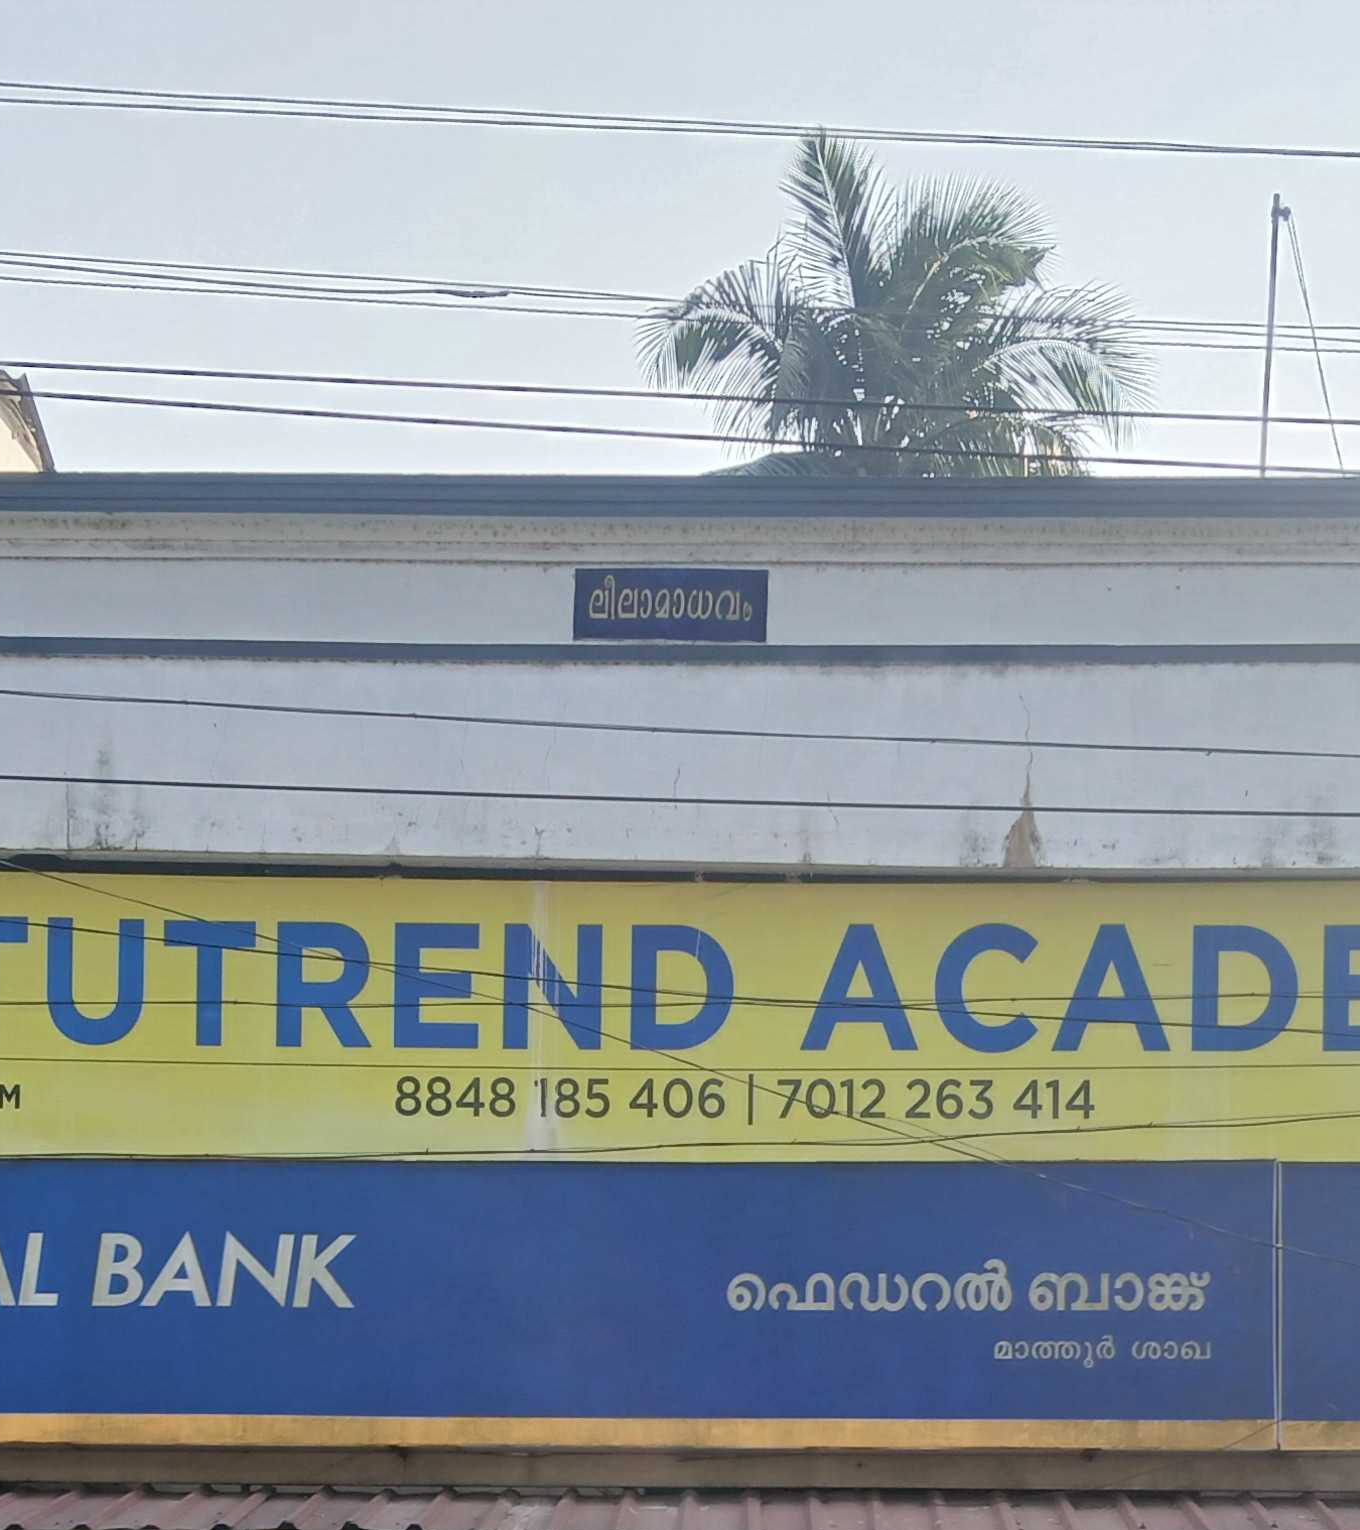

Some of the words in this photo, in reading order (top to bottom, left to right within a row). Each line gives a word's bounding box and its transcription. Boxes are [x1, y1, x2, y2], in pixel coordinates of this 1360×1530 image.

[394, 1075, 517, 1118] 8848
[533, 1077, 611, 1119] 185
[628, 1077, 726, 1120] 406
[776, 1078, 887, 1120] 7012
[904, 1078, 994, 1120] 263
[1012, 1078, 1096, 1121] 414
[91, 1231, 357, 1309] BANK
[726, 1258, 1014, 1313] ഫെഡറൽ
[1028, 1269, 1213, 1313] ബാങ്ക്
[1130, 1340, 1213, 1361] ശാഖ
